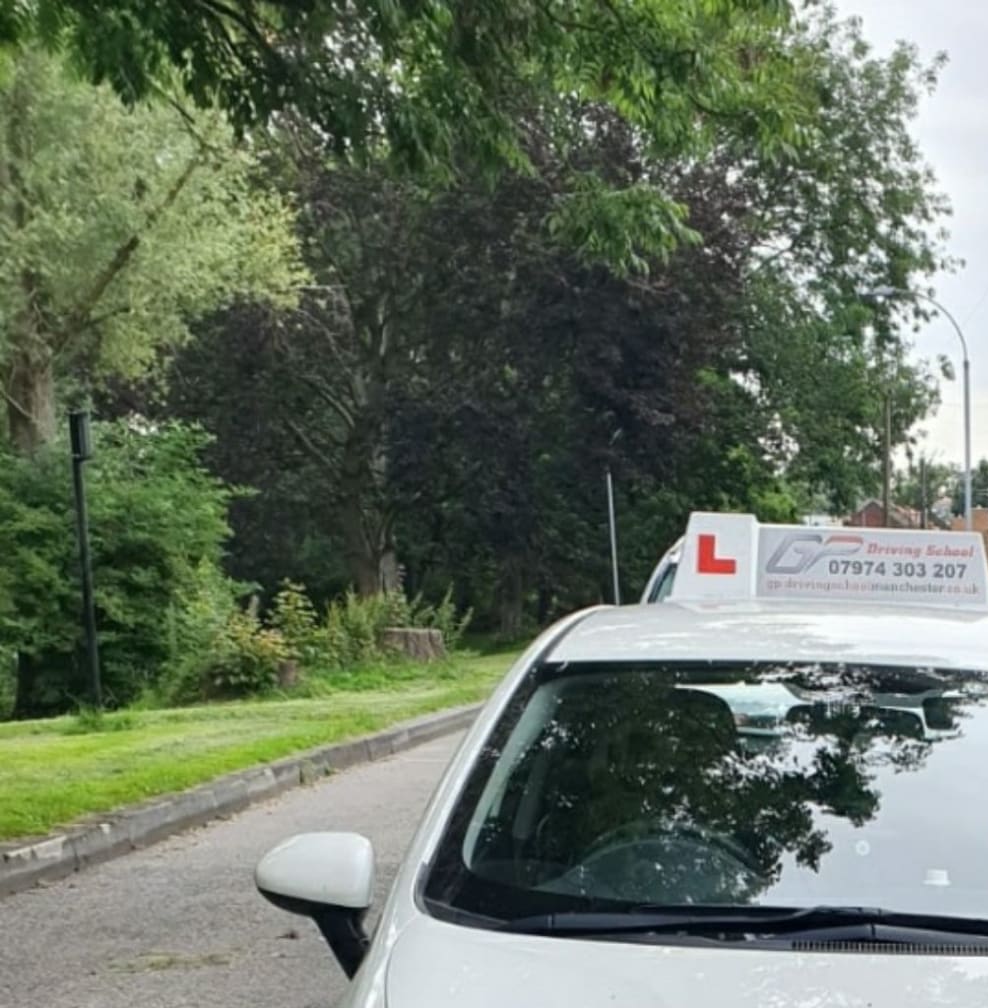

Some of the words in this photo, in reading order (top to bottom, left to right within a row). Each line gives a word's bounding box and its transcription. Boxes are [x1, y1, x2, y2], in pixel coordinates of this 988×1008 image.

[697, 534, 736, 574] L
[866, 543, 921, 559] Driving
[926, 544, 974, 557] School
[828, 559, 886, 577] 07974
[893, 561, 926, 577] 303
[933, 562, 967, 578] 207
